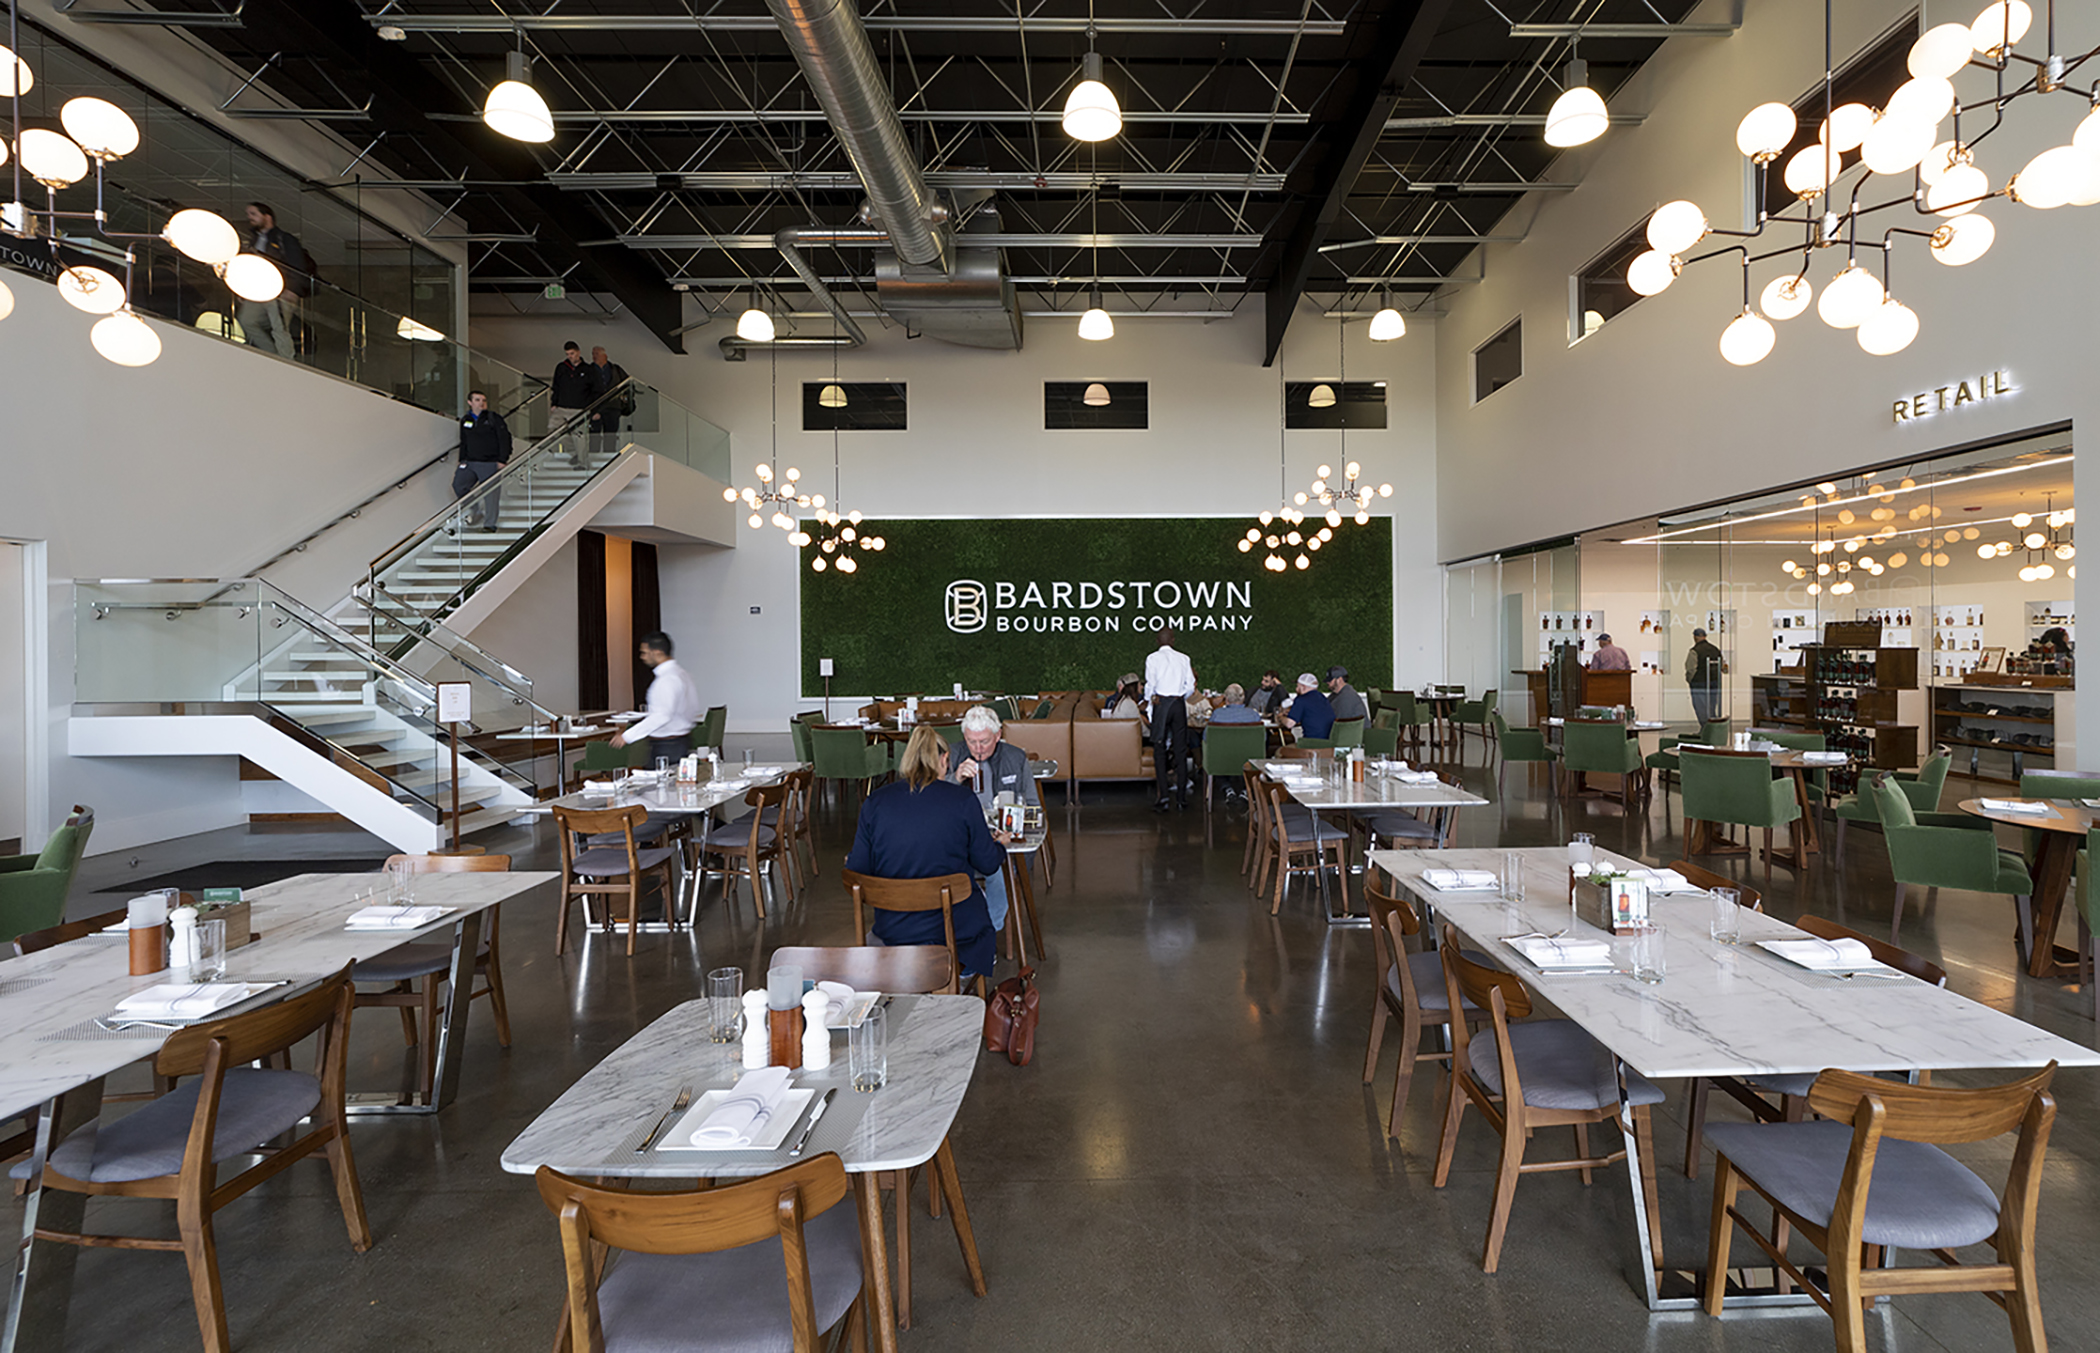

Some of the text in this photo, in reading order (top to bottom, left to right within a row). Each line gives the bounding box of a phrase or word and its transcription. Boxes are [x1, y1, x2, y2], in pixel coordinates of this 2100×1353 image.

[0, 245, 58, 277] TOWN
[1893, 371, 2011, 423] RETAIL
[995, 581, 1251, 609] BARDSTOWN
[996, 614, 1253, 632] BOURBON COMPANY
